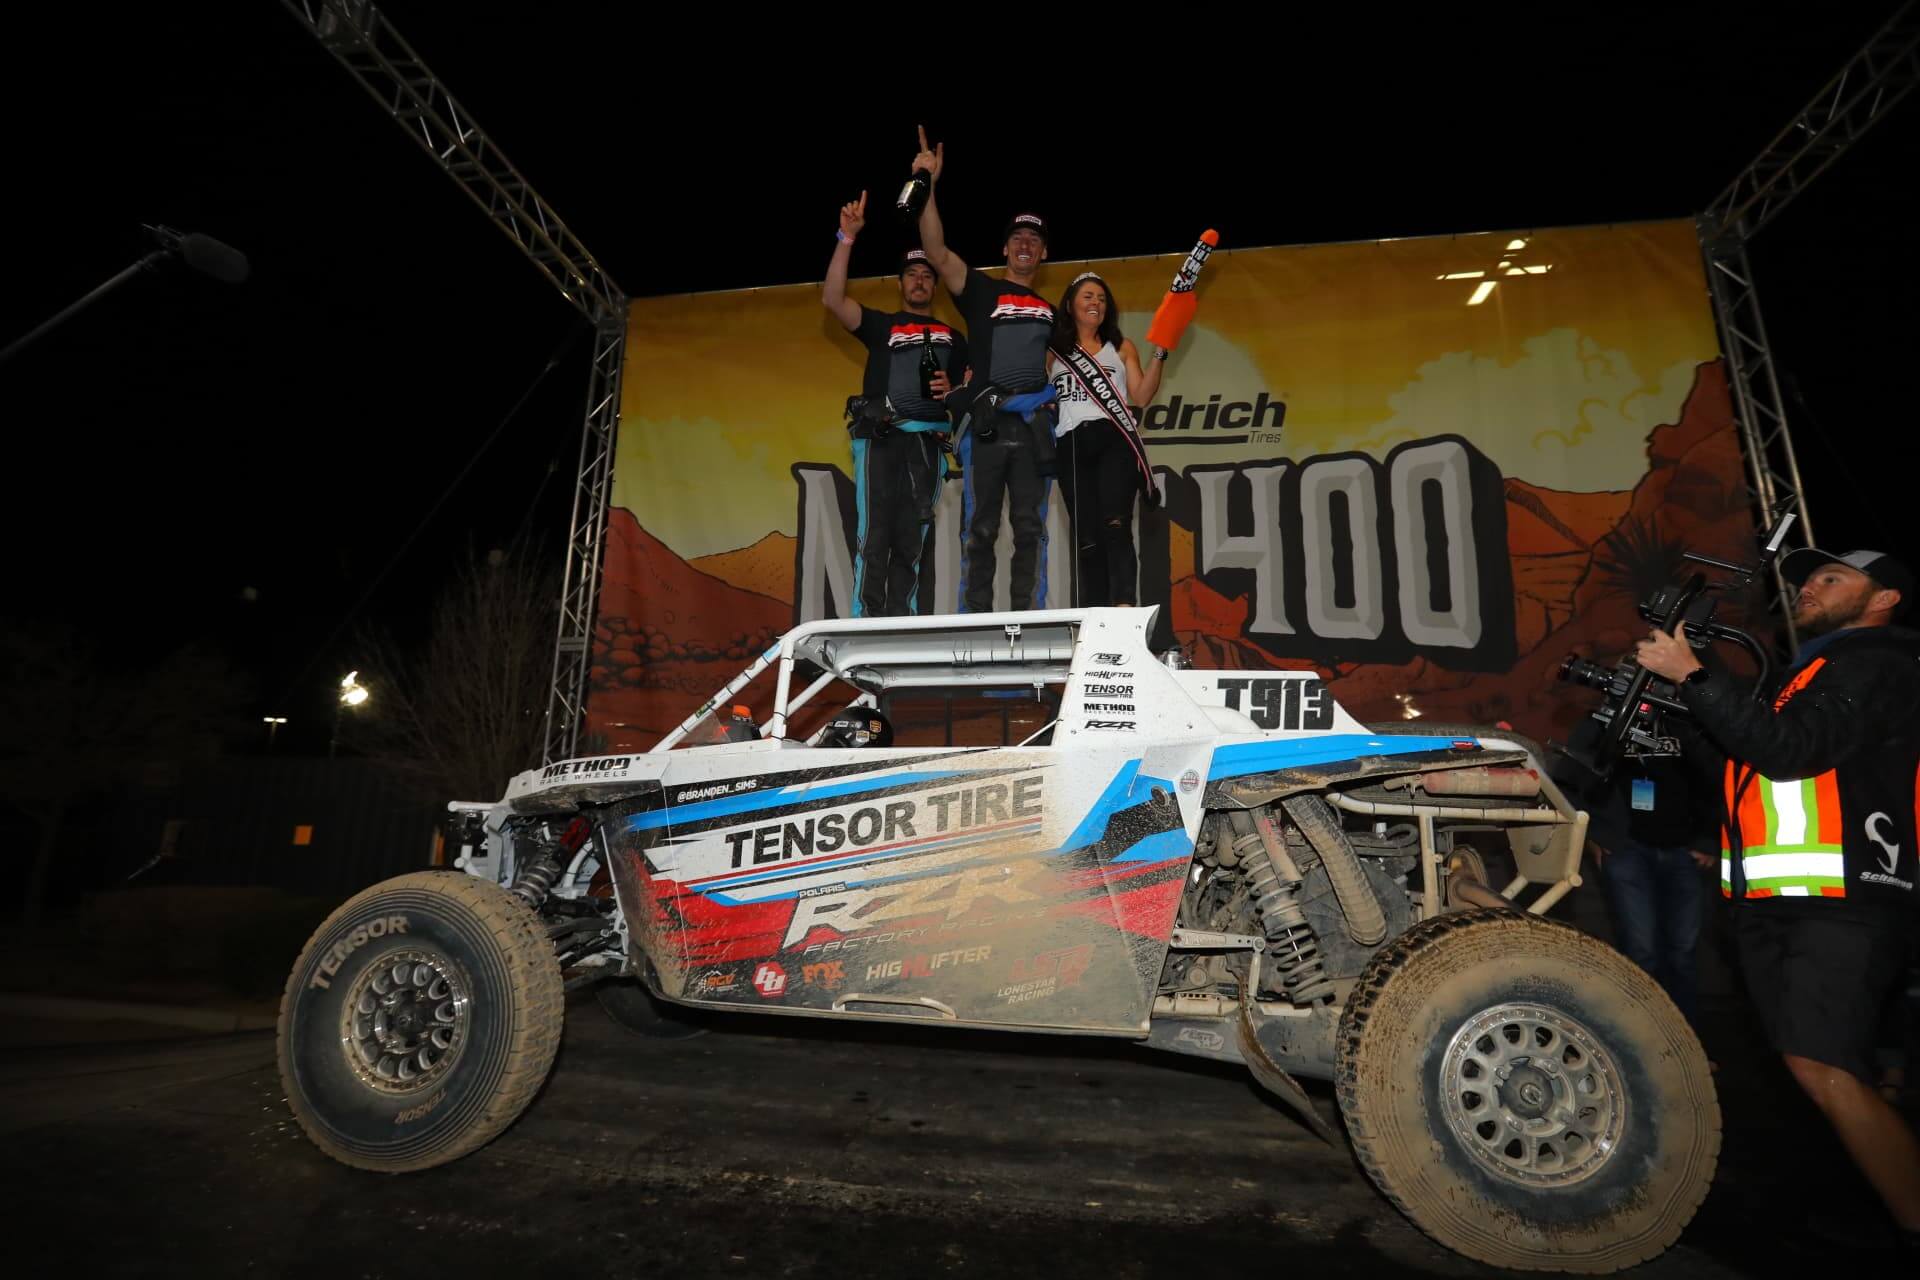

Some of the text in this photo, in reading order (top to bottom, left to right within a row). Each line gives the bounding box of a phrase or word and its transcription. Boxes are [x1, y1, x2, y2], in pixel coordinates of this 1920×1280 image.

[1071, 391, 1088, 402] 913
[1091, 377, 1112, 399] 400
[1250, 431, 1281, 443] Tires
[1192, 441, 1480, 648] 400
[1084, 684, 1134, 694] TENSOR
[1084, 703, 1136, 712] METHOD
[1218, 676, 1335, 731] T913
[1084, 721, 1137, 730] RZR
[538, 770, 629, 786] RACE WHEELS
[542, 757, 631, 779] METHOD
[677, 779, 758, 803] @BRANDEN_SIMS
[725, 774, 1044, 869] TENSOR TIRE
[798, 882, 846, 899] POLARIS
[782, 857, 1048, 950] RZR
[803, 927, 929, 956] FACTORY
[309, 916, 409, 990] TENSOR
[802, 959, 849, 988] FOX
[998, 977, 1057, 998] LONESTAR
[1007, 986, 1056, 1005] RACING
